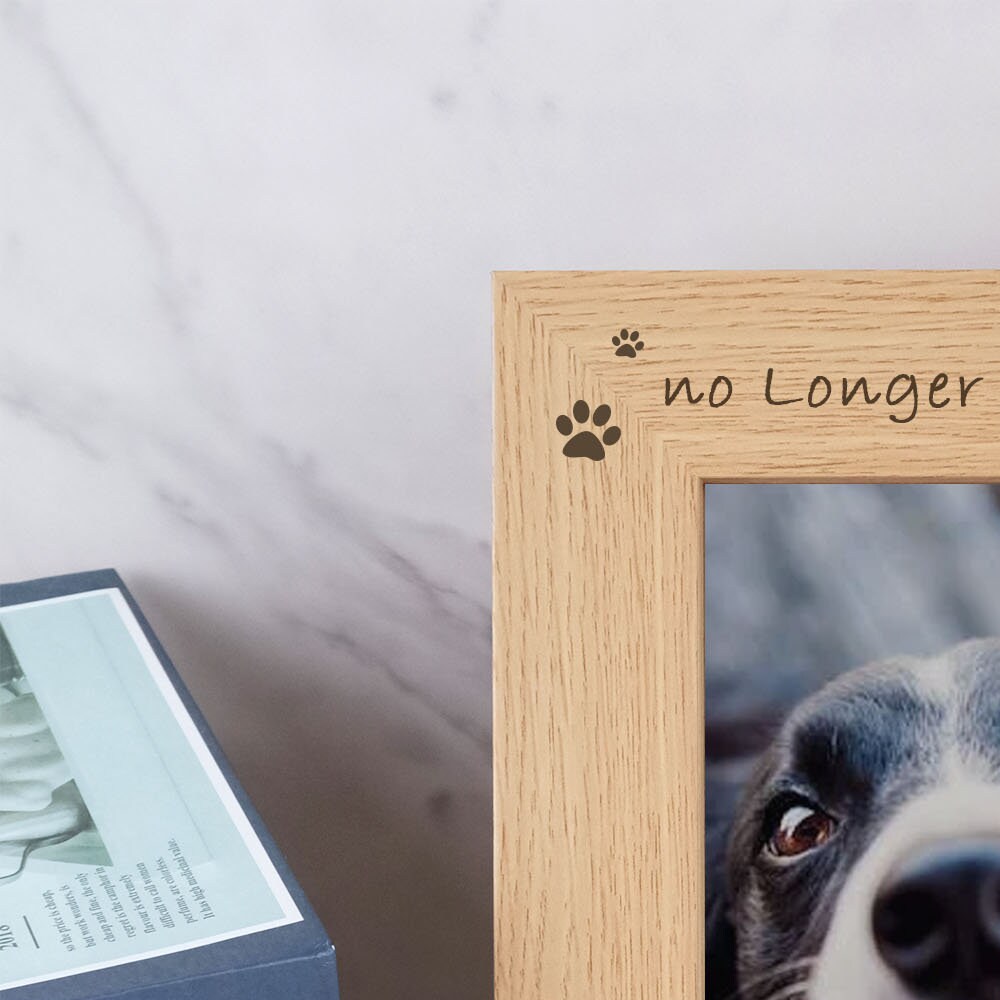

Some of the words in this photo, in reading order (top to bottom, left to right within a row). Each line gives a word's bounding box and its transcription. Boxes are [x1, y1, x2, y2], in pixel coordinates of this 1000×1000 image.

[664, 375, 733, 408] no
[764, 367, 984, 423] Longer
[94, 866, 106, 875] in
[136, 862, 152, 885] women
[74, 873, 89, 886] only
[81, 886, 94, 897] the
[119, 874, 141, 904] extremely
[143, 884, 159, 897] call
[168, 884, 180, 895] are
[111, 901, 124, 912] the
[152, 896, 163, 904] to
[198, 900, 212, 913] has
[48, 909, 60, 917] is
[133, 903, 145, 911] is
[91, 911, 107, 924] and
[115, 911, 127, 919] is
[202, 911, 215, 920] It
[53, 917, 71, 933] price
[74, 918, 89, 936] work
[119, 918, 136, 938] regret
[138, 911, 156, 934] flavour
[60, 933, 72, 944] the
[100, 923, 116, 942] cheap
[66, 944, 75, 952] so
[82, 935, 96, 948] but
